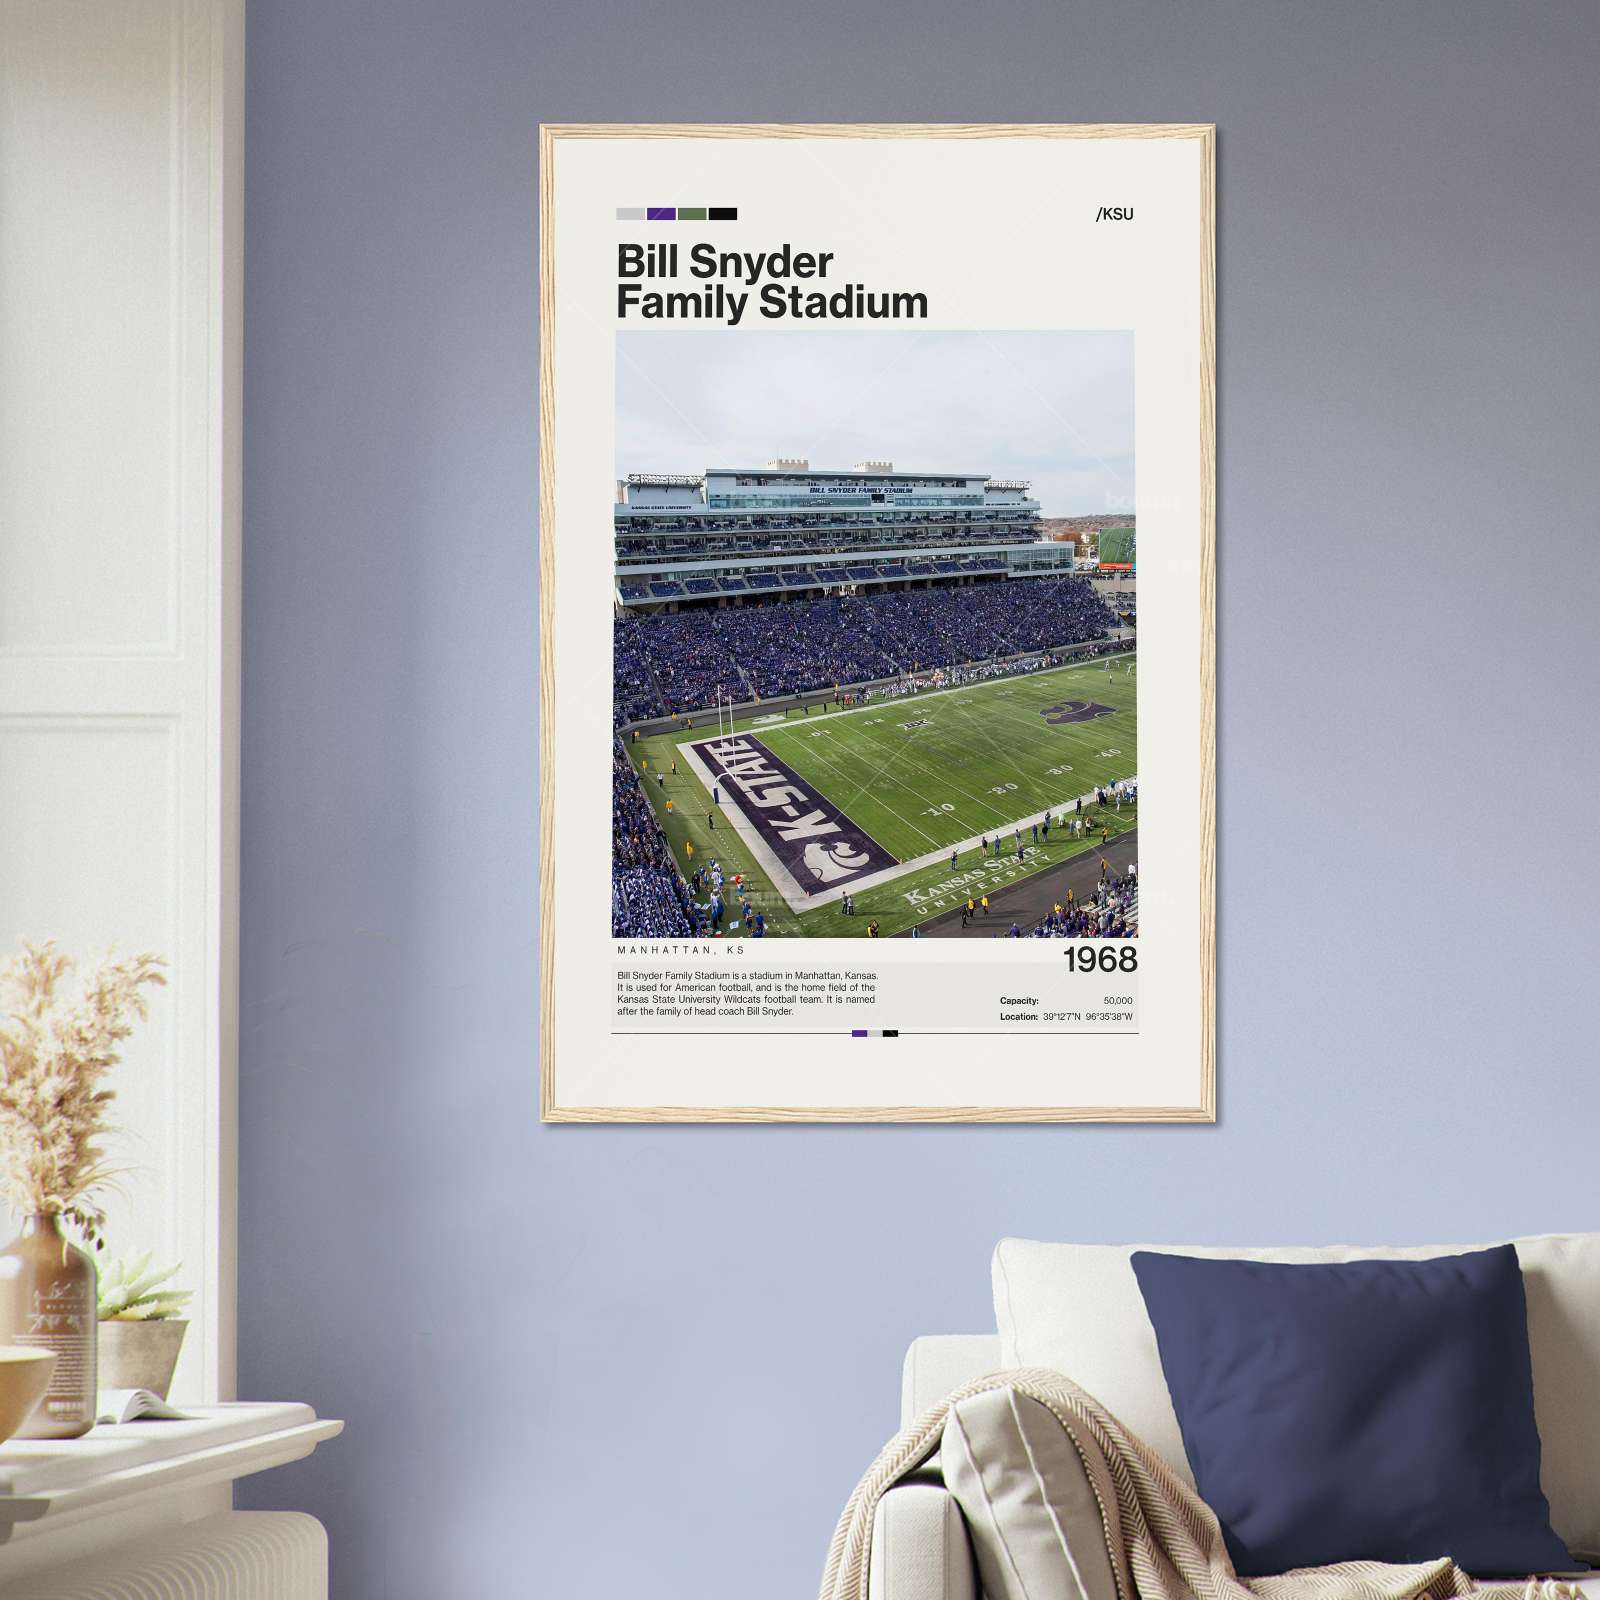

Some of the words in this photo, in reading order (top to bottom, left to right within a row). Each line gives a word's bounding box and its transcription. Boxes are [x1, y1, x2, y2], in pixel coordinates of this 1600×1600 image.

[1095, 206, 1134, 222] /KSU
[617, 243, 678, 278] Bill
[689, 243, 834, 286] Snyder
[617, 283, 749, 326] Family
[759, 283, 928, 319] Stadium
[703, 739, 843, 843] K-STATE
[902, 868, 986, 906] KANSAS
[916, 855, 1051, 916] UNIVERSITY
[617, 945, 717, 956] MANHATTAN,
[727, 945, 744, 955] KS
[1063, 946, 1139, 973] 1968
[617, 971, 631, 980] Bill
[632, 971, 663, 982] Snyder
[665, 971, 693, 982] Family
[694, 971, 730, 980] Stadium
[732, 971, 739, 980] is
[749, 971, 783, 980] stadium
[785, 971, 793, 980] in
[795, 971, 842, 982] Manhattan,
[844, 971, 879, 980] Kansas.
[617, 983, 623, 992] It
[626, 983, 634, 992] is
[636, 983, 657, 992] used
[660, 983, 672, 992] for
[675, 983, 716, 992] American
[719, 983, 753, 993] football,
[755, 983, 772, 992] and
[774, 983, 783, 992] is
[785, 983, 799, 992] the
[801, 983, 826, 992] home
[828, 983, 847, 992] field
[849, 983, 858, 992] of
[861, 983, 876, 992] the
[617, 995, 649, 1004] Kansas
[652, 995, 676, 1004] State
[678, 995, 721, 1006] University
[724, 995, 761, 1004] Wildcats
[764, 995, 797, 1004] football
[800, 995, 823, 1004] team.
[826, 995, 833, 1004] It
[835, 995, 843, 1004] is
[846, 995, 876, 1004] named
[1000, 996, 1039, 1006] Capacity:
[1103, 996, 1133, 1005] 50,000
[617, 1006, 638, 1016] after
[640, 1006, 654, 1016] the
[656, 1006, 682, 1017] family
[683, 1006, 693, 1016] of
[695, 1006, 716, 1016] head
[718, 1006, 745, 1016] coach
[747, 1006, 760, 1016] Bill
[761, 1006, 794, 1017] Snyder.
[1000, 1012, 1039, 1021] Location:
